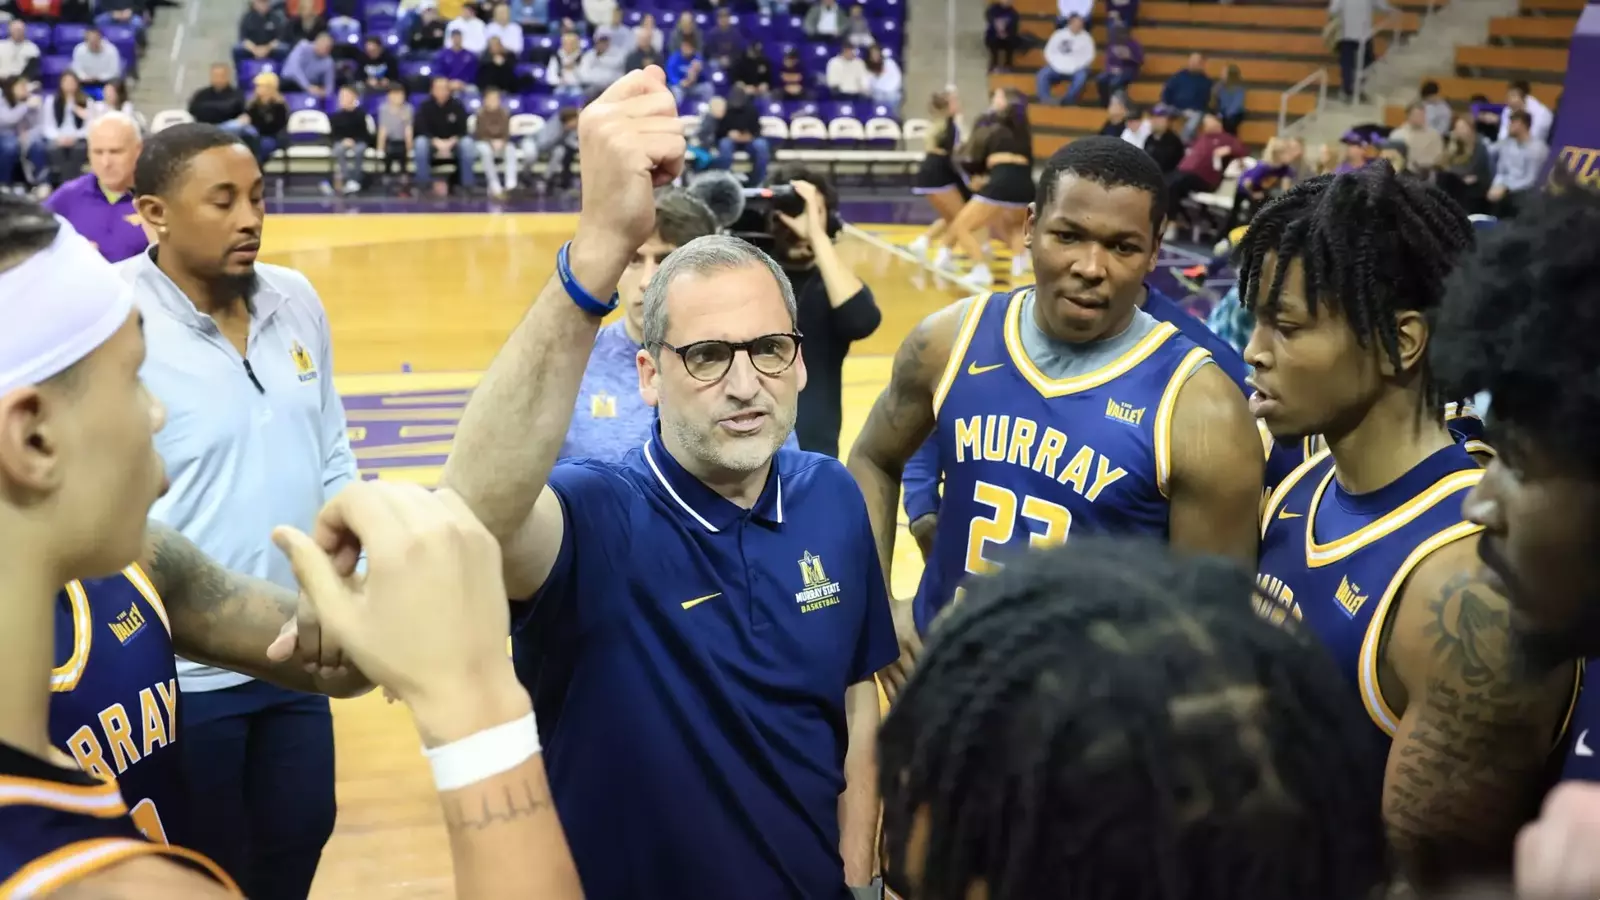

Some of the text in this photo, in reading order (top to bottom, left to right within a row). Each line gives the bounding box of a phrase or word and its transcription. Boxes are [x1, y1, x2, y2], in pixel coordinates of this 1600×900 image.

[1105, 397, 1147, 425] VALLEY
[955, 415, 1128, 503] MURRAY
[964, 480, 1072, 576] 23
[795, 582, 841, 603] MURRAY STATE
[801, 596, 841, 613] BASKETBALL
[1335, 574, 1369, 616] VALLEY
[107, 601, 146, 644] VALLEY
